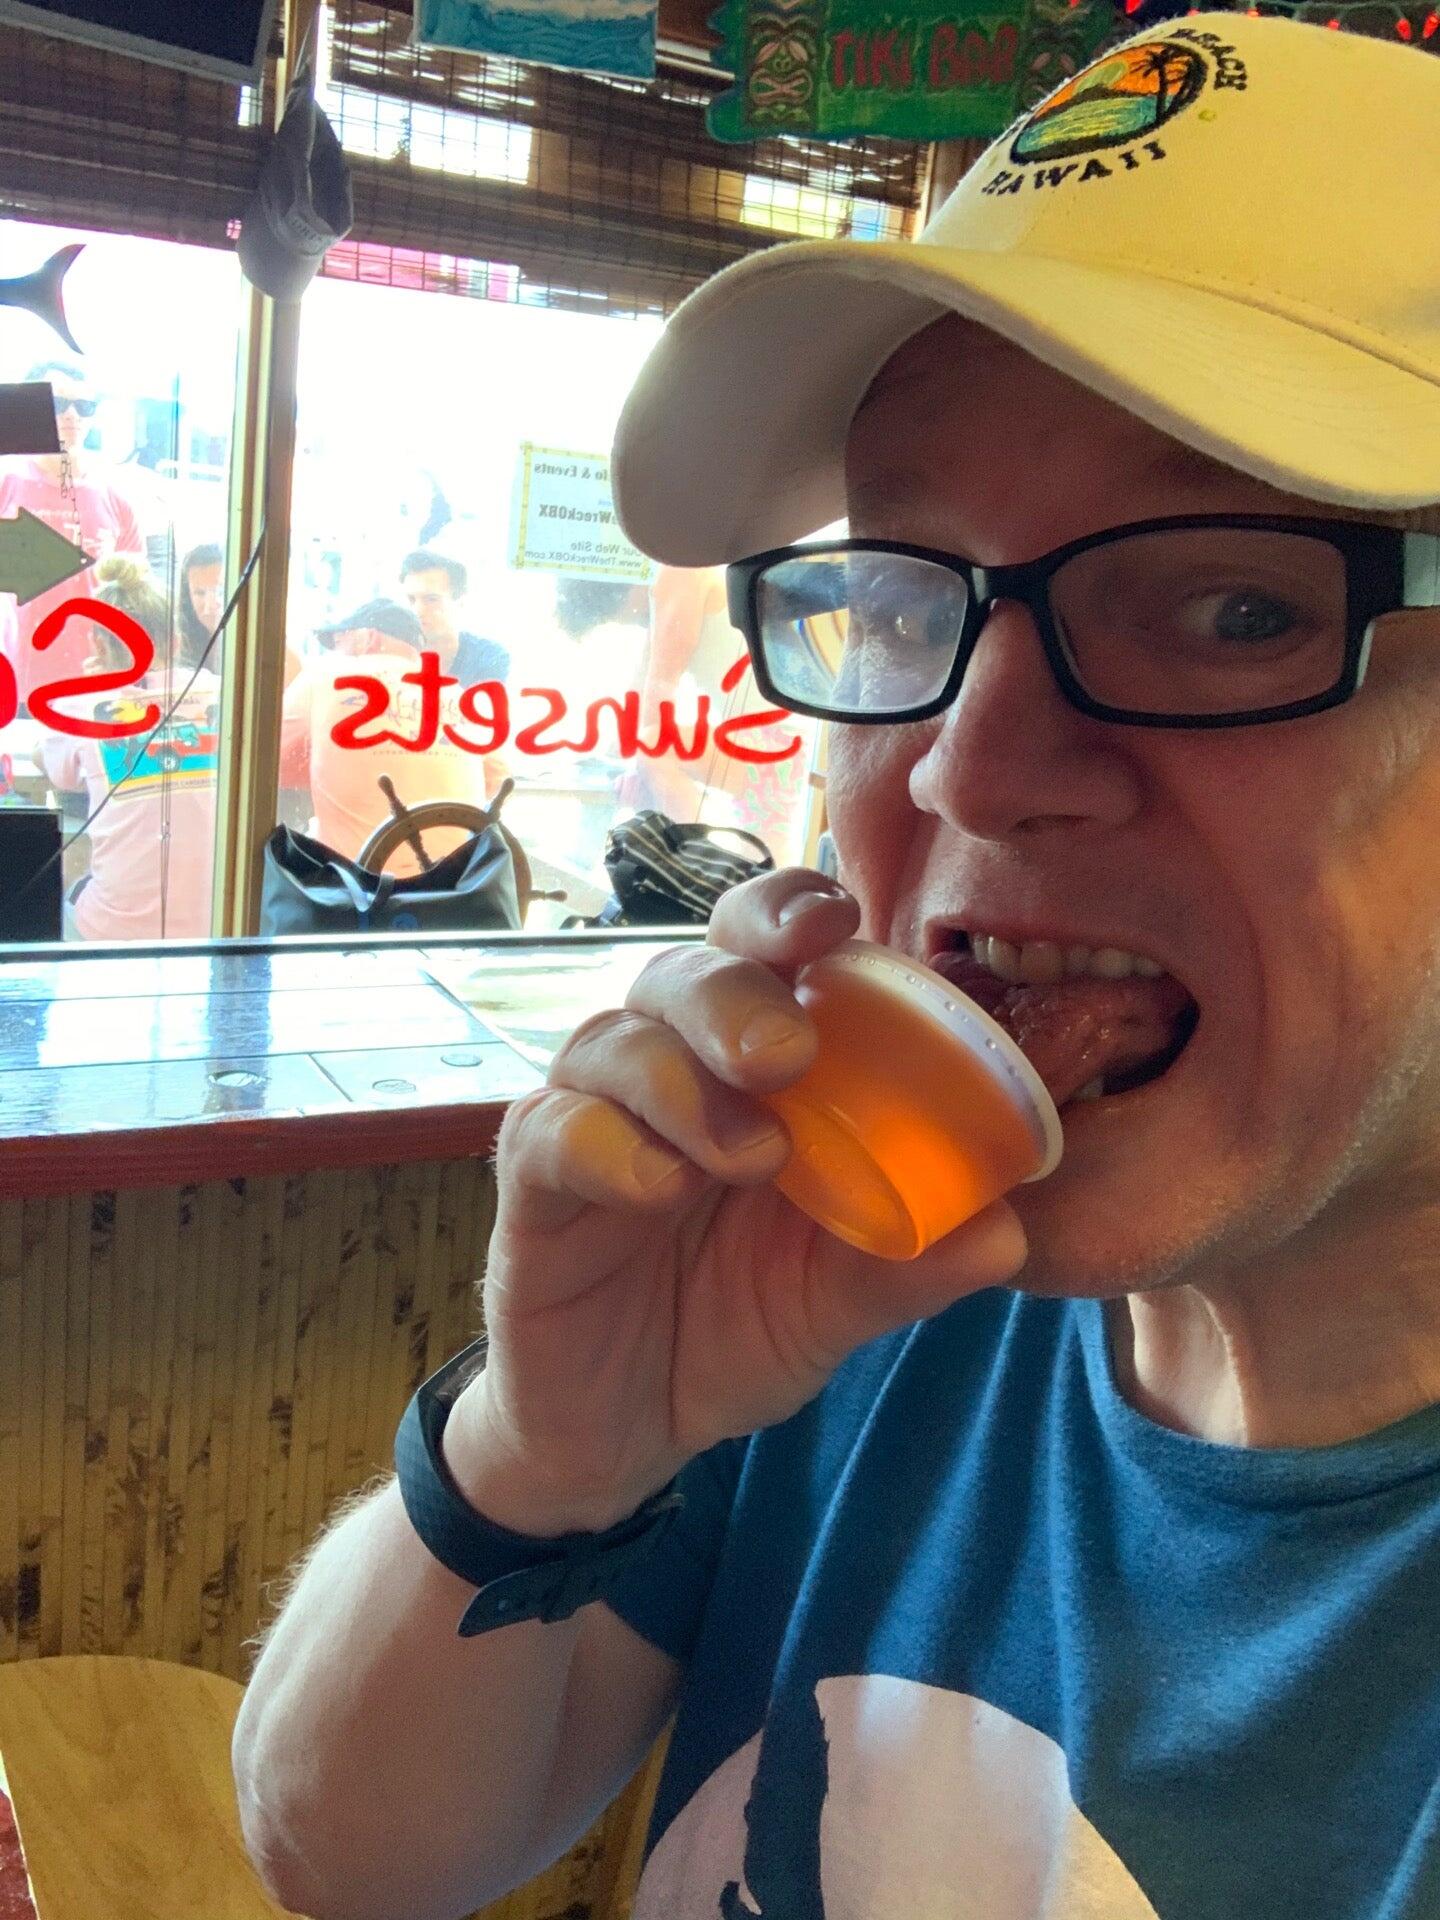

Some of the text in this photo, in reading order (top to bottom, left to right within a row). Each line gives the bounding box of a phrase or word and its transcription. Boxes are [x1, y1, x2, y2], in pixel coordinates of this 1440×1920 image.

[832, 24, 1019, 87] TIKI BAR
[981, 140, 1166, 195] HAWAII
